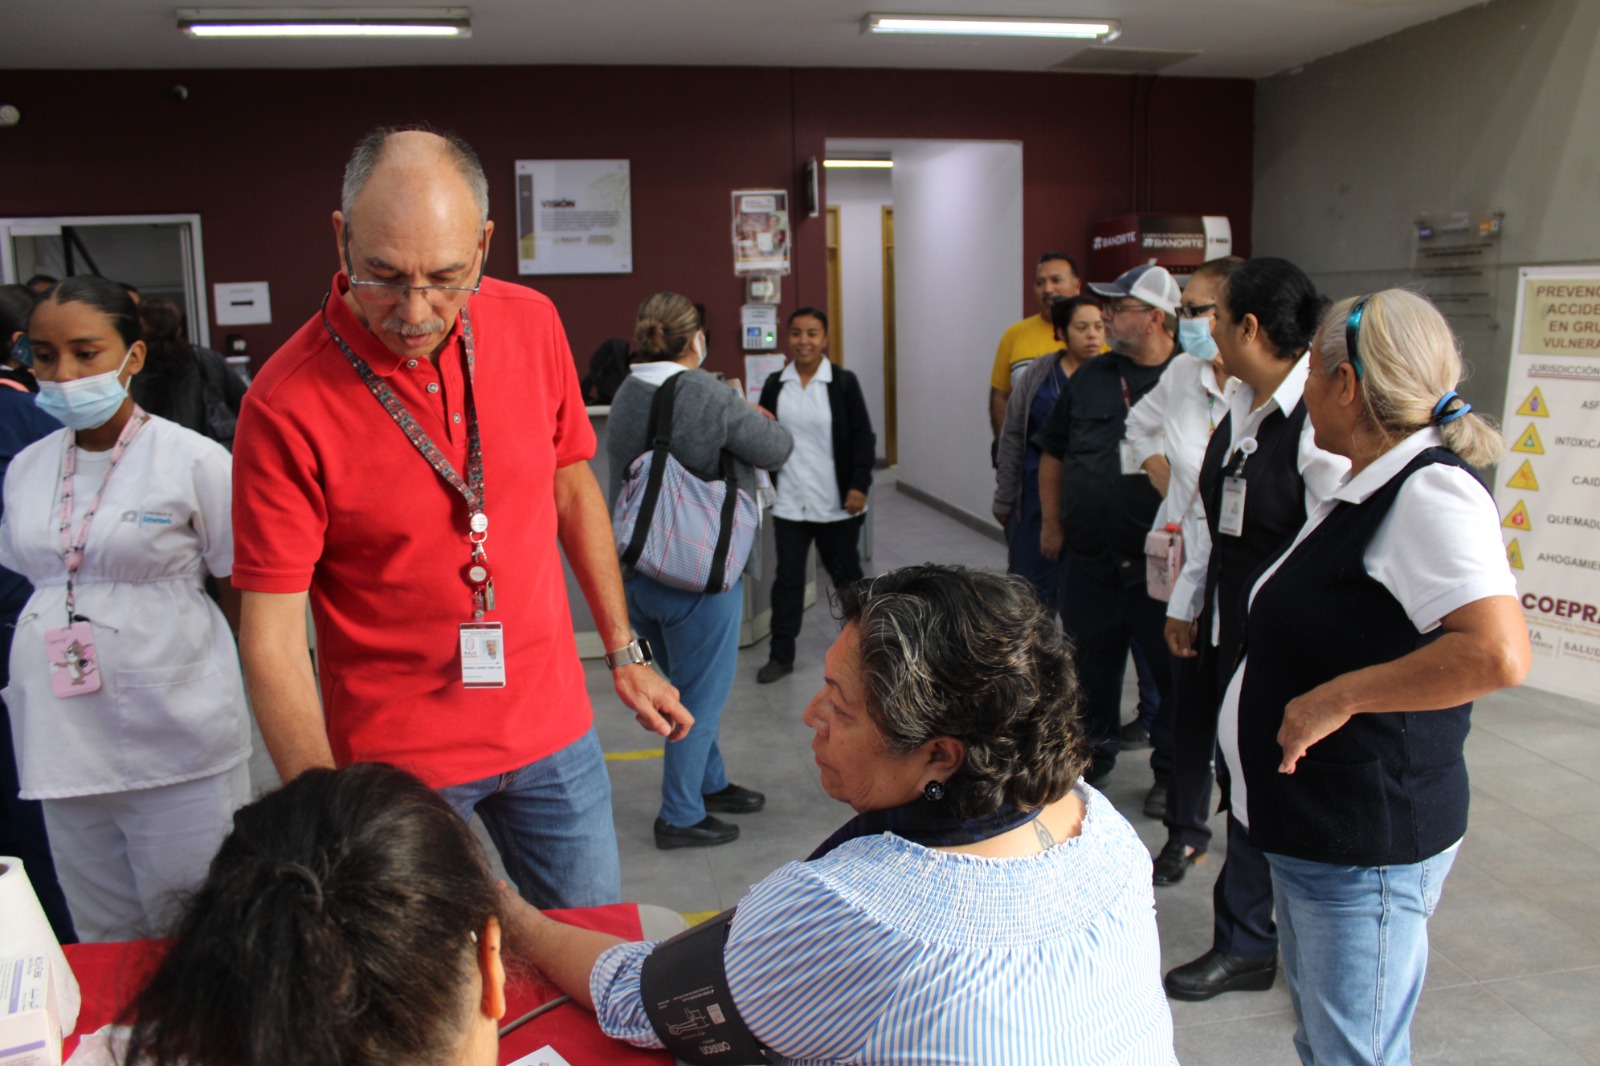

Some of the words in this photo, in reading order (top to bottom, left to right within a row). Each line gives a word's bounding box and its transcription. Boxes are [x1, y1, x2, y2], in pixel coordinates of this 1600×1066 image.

[1103, 232, 1136, 247] BANORTE
[1154, 239, 1204, 248] BANORTE
[1547, 303, 1600, 316] ACCIDE
[1549, 320, 1569, 333] EN
[1537, 553, 1600, 571] AHOGAMIE
[1522, 593, 1600, 623] COEPR
